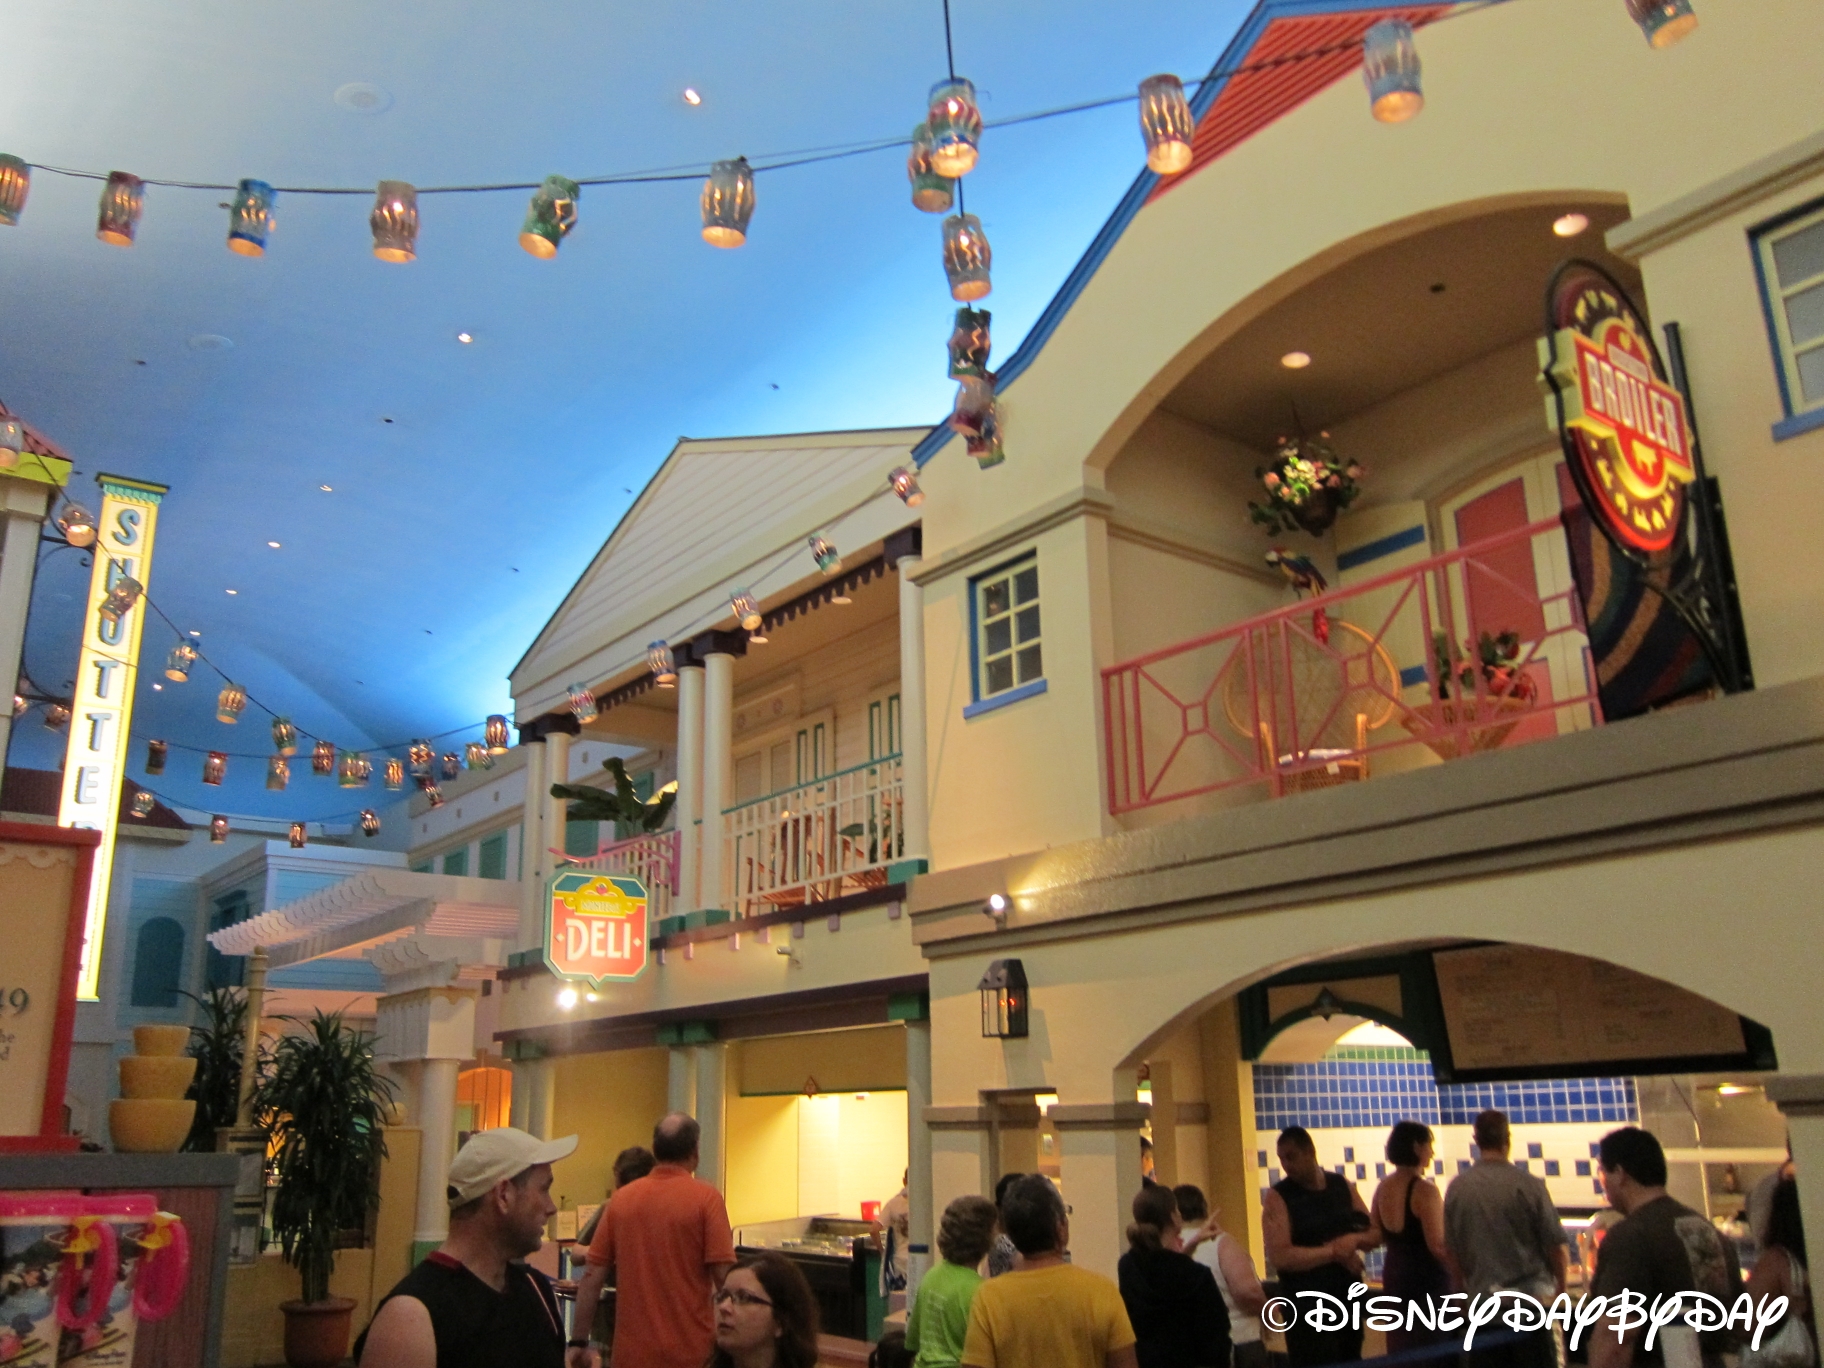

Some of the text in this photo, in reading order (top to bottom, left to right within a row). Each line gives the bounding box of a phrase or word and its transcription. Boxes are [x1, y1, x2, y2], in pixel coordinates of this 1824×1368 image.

[1584, 351, 1683, 456] BROILER
[72, 508, 141, 828] SHUTTE
[565, 917, 631, 961] DELI
